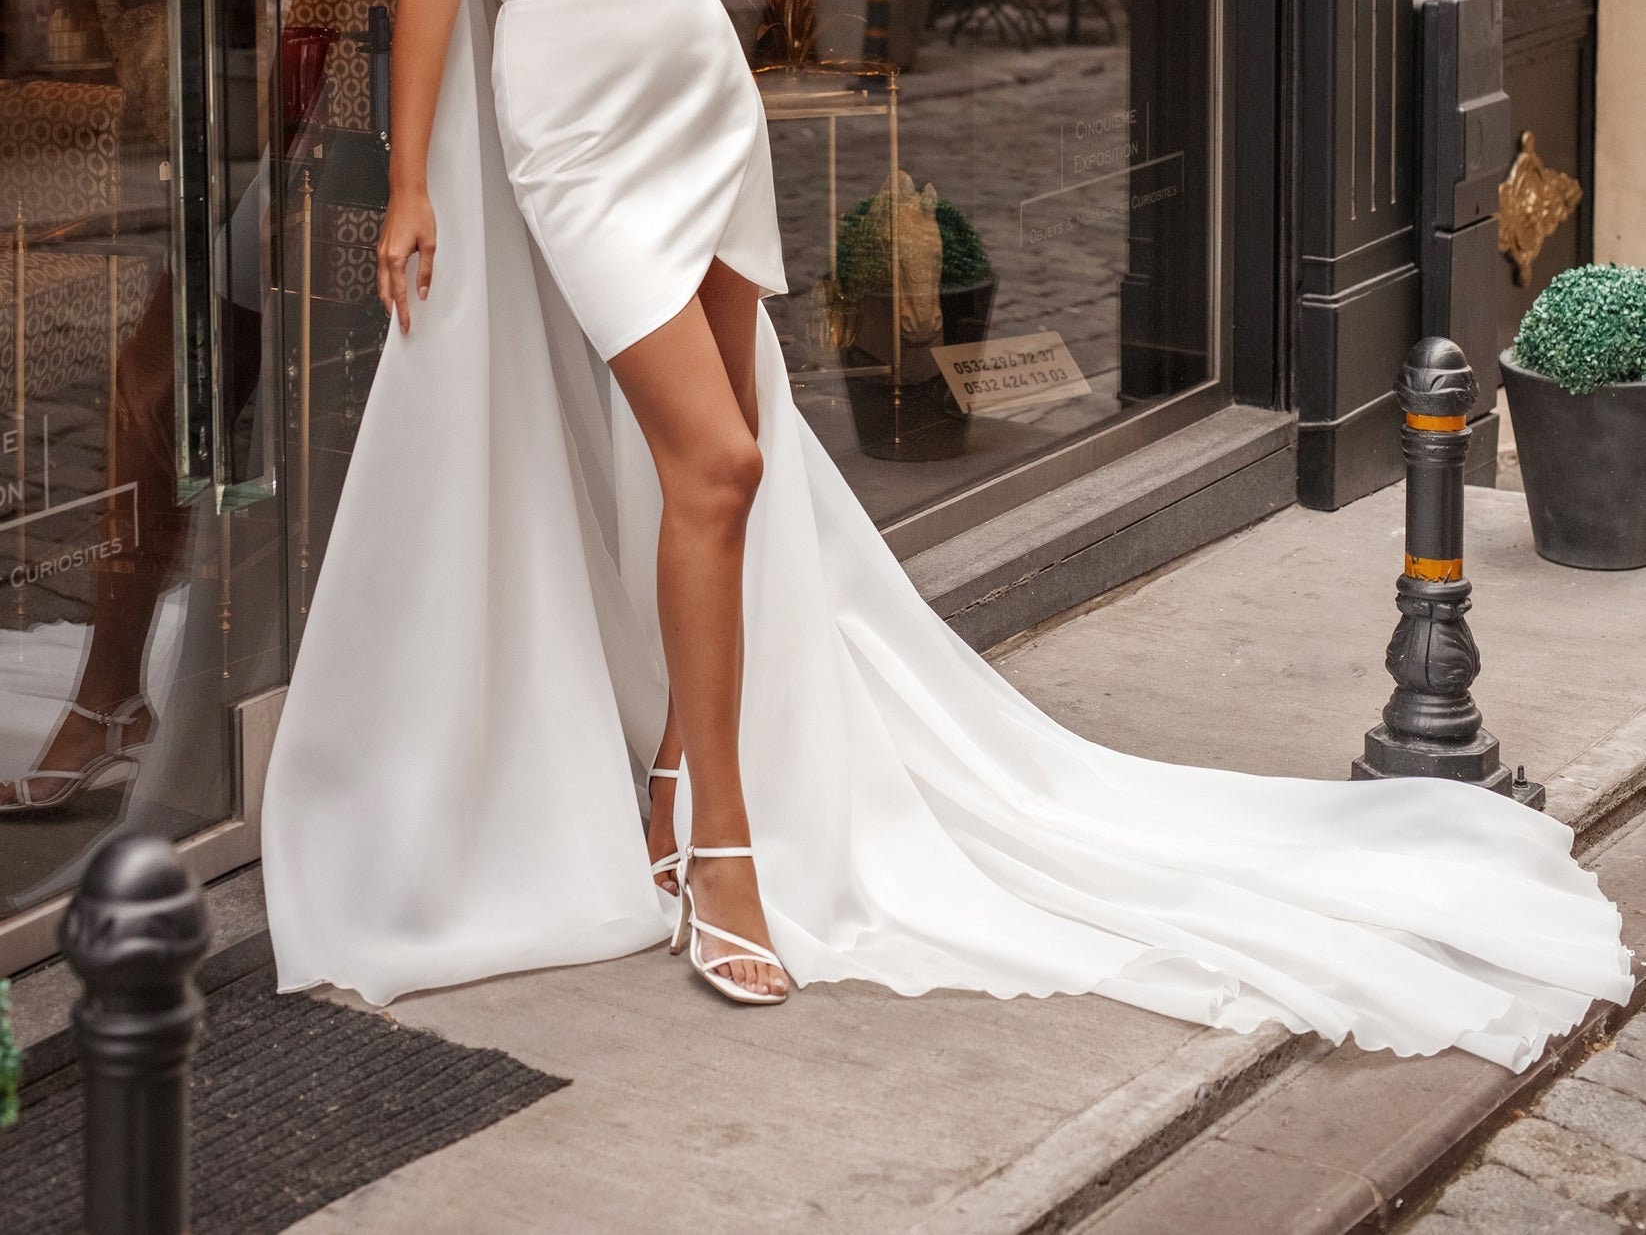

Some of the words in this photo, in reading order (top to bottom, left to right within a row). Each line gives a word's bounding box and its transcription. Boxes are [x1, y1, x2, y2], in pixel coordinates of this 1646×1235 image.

[1073, 141, 1139, 174] EXPOSITION
[1131, 185, 1178, 209] CURIOSITES
[953, 360, 990, 375] 0532
[964, 379, 1000, 395] 0532
[1002, 375, 1029, 389] 424
[1029, 371, 1048, 385] 13
[1049, 368, 1068, 382] 03
[10, 537, 123, 588] CURIOSITES
